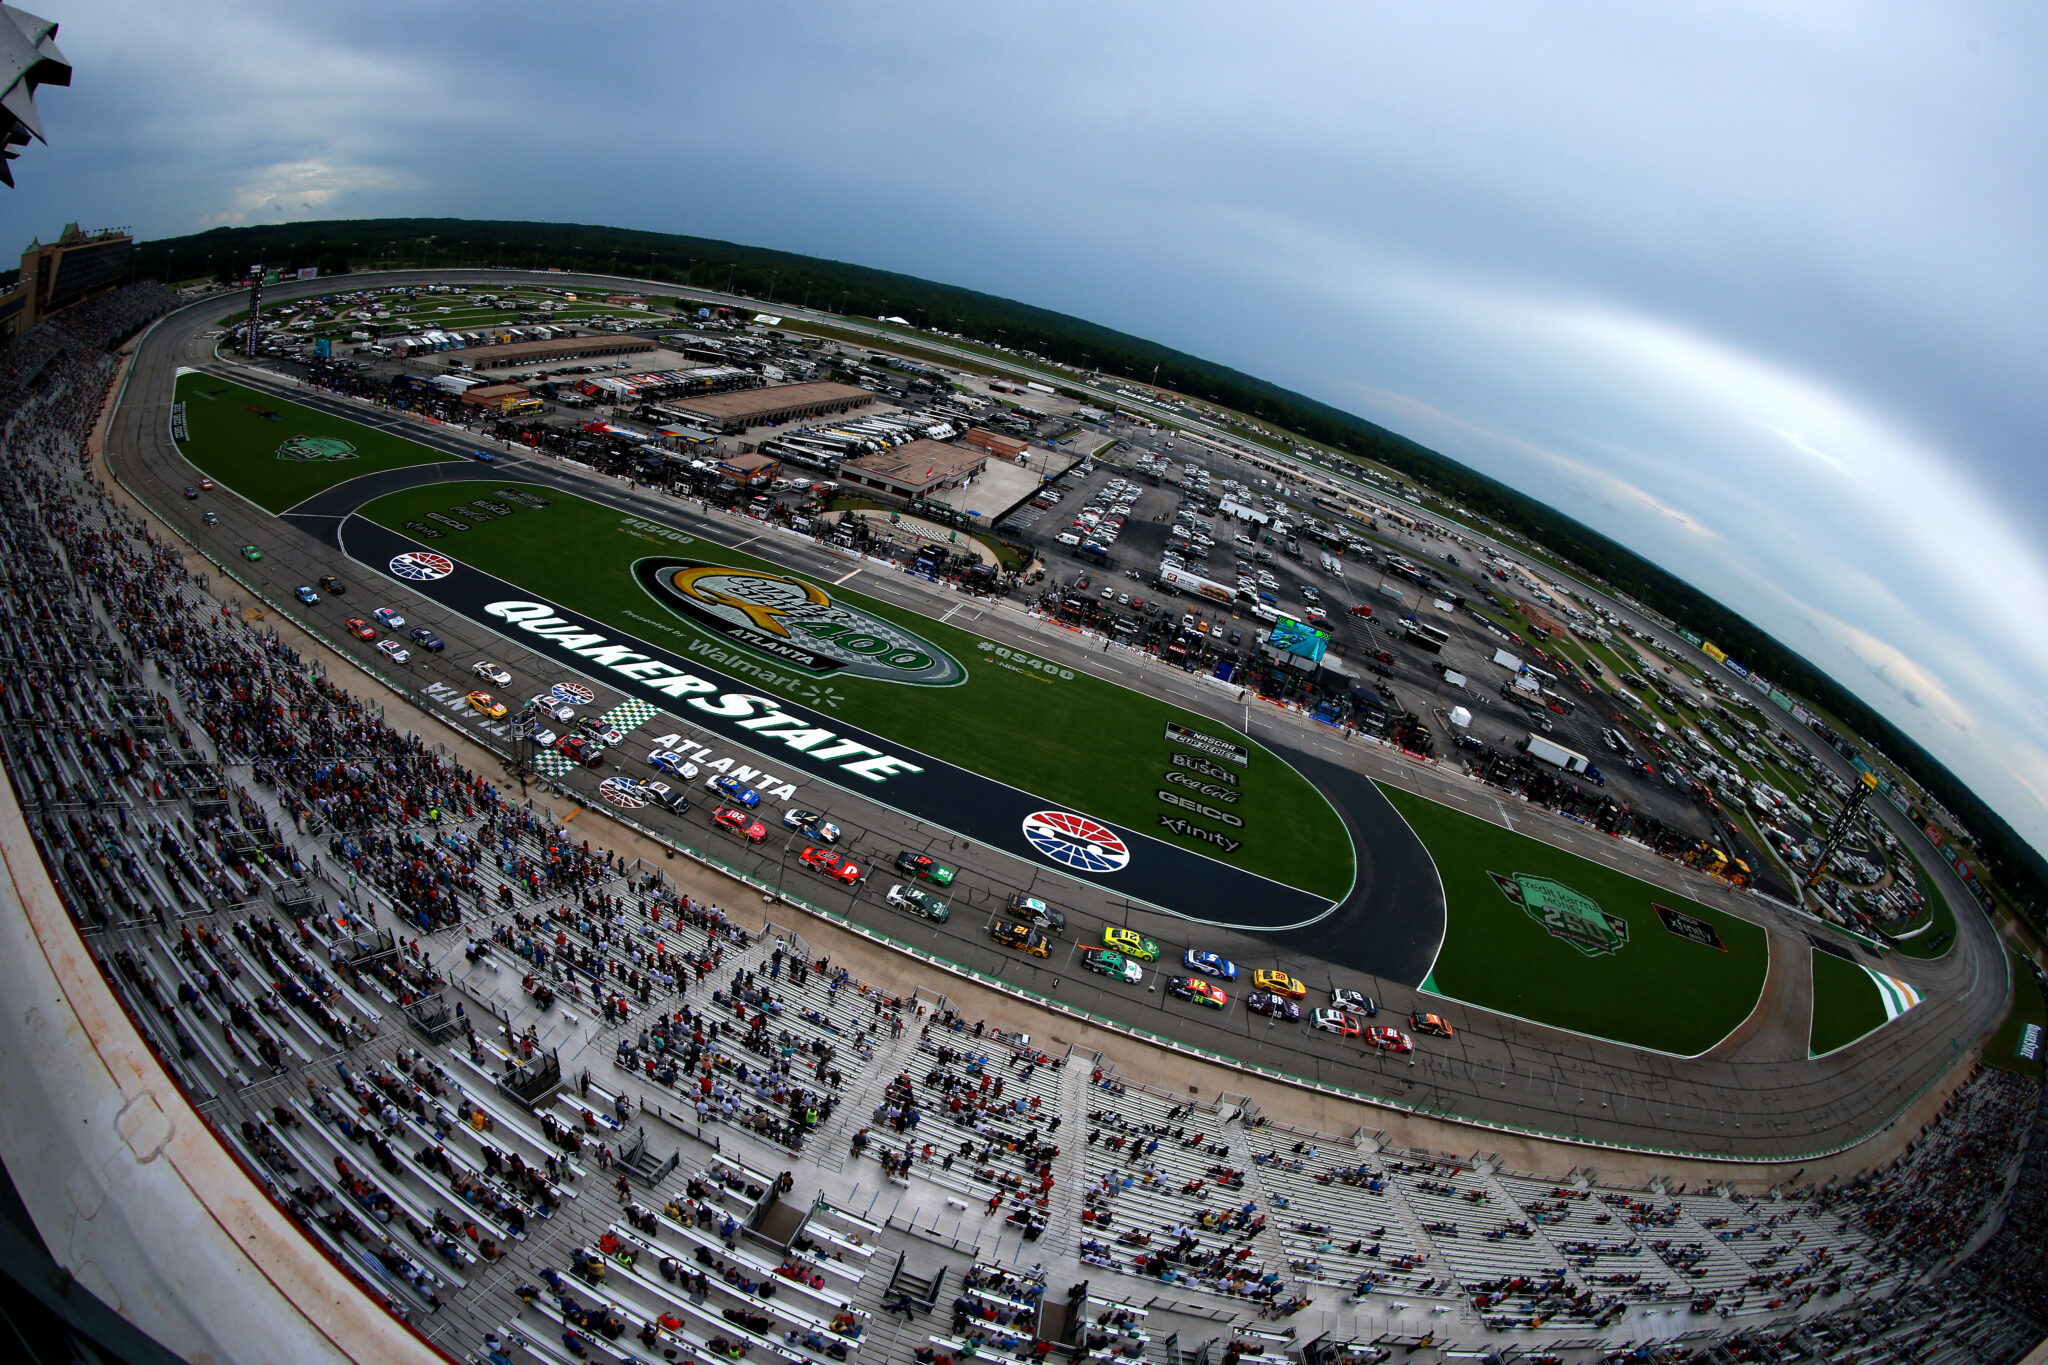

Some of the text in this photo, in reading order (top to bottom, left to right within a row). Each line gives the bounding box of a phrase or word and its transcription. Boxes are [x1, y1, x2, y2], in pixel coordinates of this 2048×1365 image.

[727, 575, 852, 619] QUAKER
[727, 628, 817, 666] ATLANTA
[788, 621, 937, 671] 400
[976, 641, 1075, 680] #QS400
[687, 639, 801, 692] Walmart
[1726, 659, 1748, 677] GEICO
[1193, 731, 1237, 752] NASCAR
[651, 733, 798, 802] ATLANTA
[1172, 753, 1238, 786] BUSCH
[1158, 790, 1243, 828] GEICO
[1159, 815, 1241, 853] xfinity
[1125, 931, 1139, 941] 21
[1541, 905, 1611, 944] 250
[1271, 993, 1284, 1005] 48
[1387, 1027, 1398, 1038] 18
